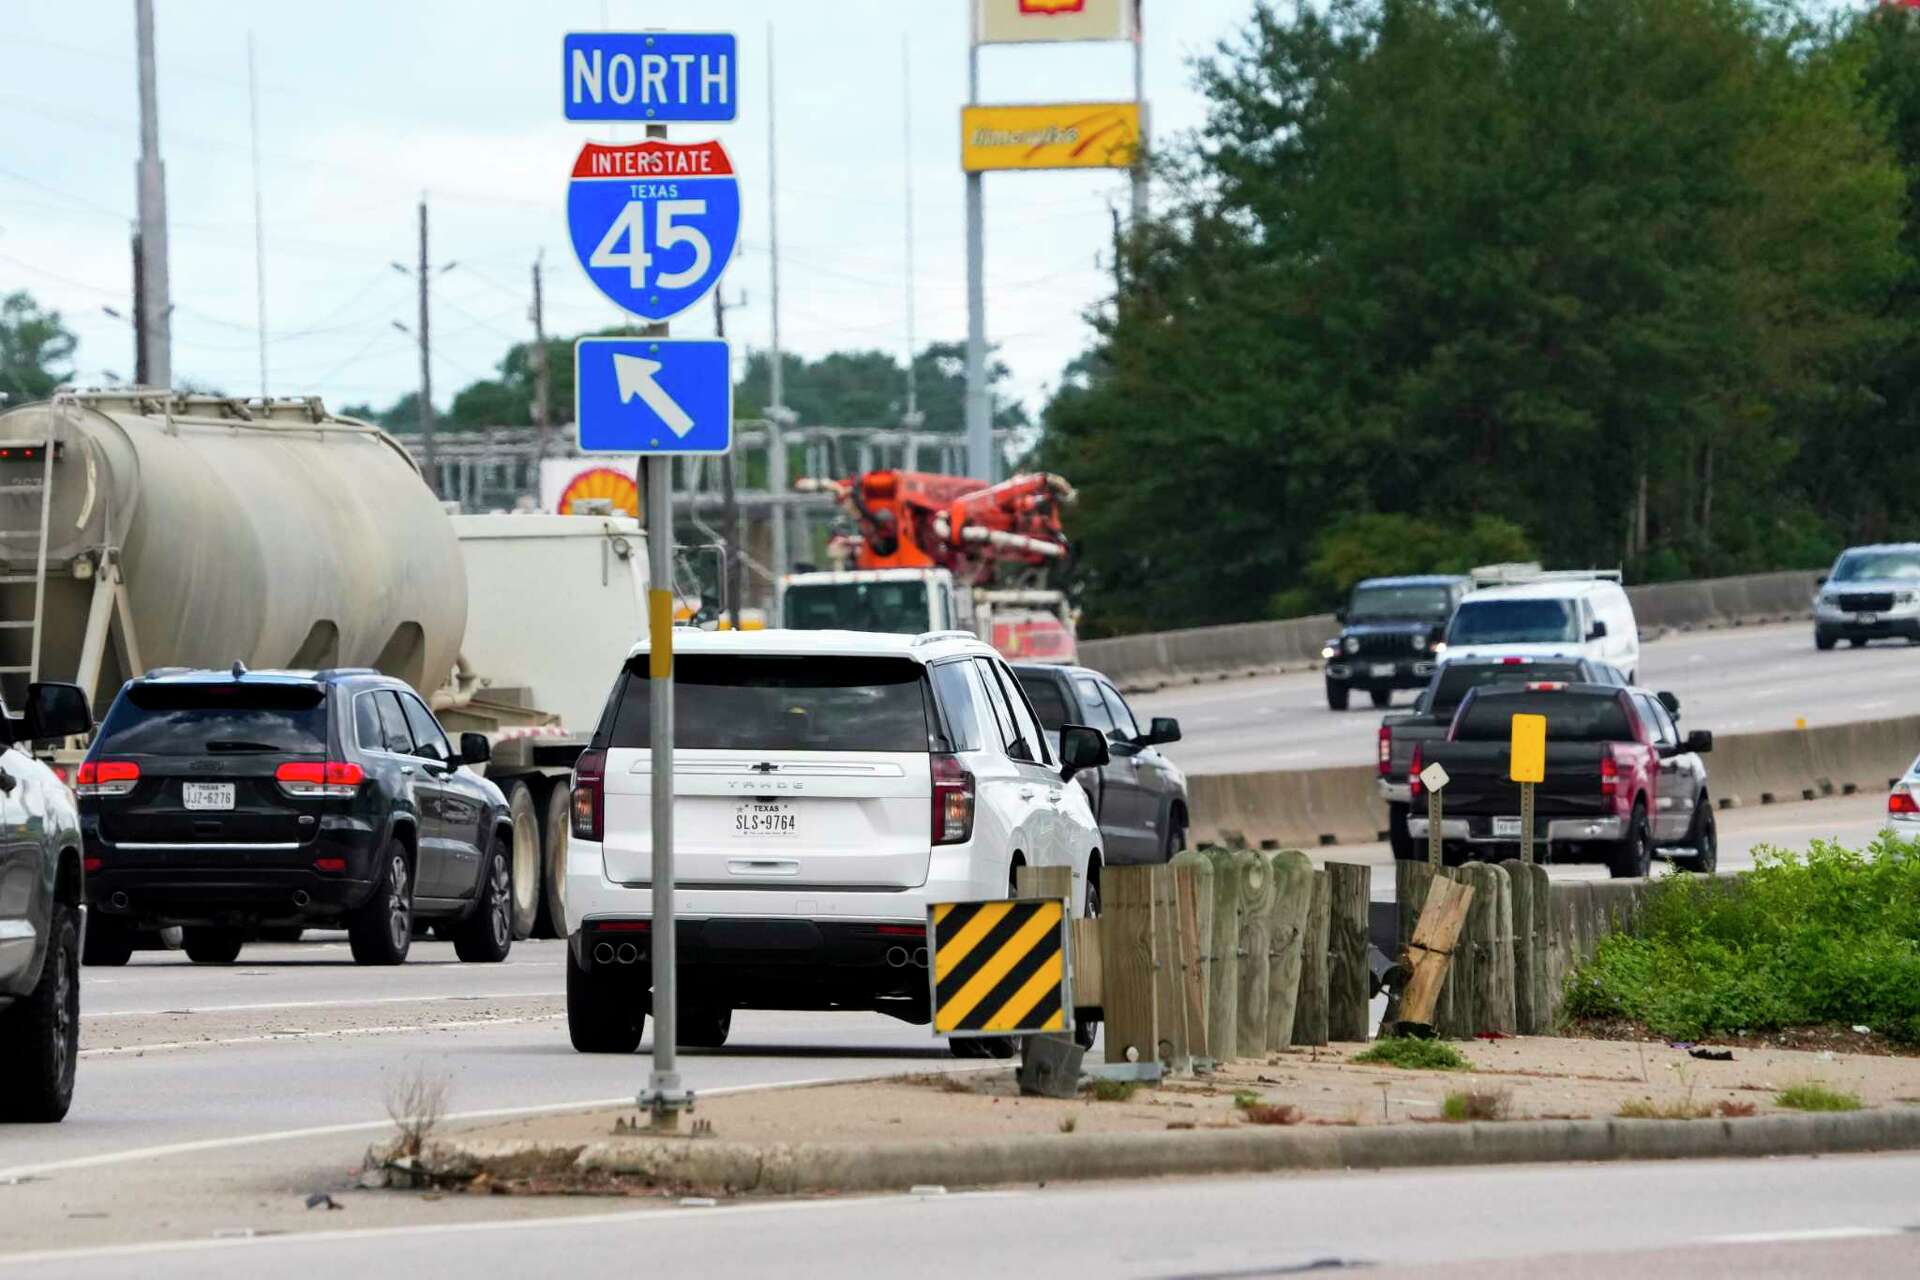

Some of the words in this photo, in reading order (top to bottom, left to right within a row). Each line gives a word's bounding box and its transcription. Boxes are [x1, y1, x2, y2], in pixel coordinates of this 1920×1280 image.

[572, 49, 728, 104] NORTH
[591, 150, 712, 174] INTERSTATE
[630, 184, 678, 198] TEXAS
[589, 199, 711, 290] 45
[754, 805, 780, 813] TEXAS
